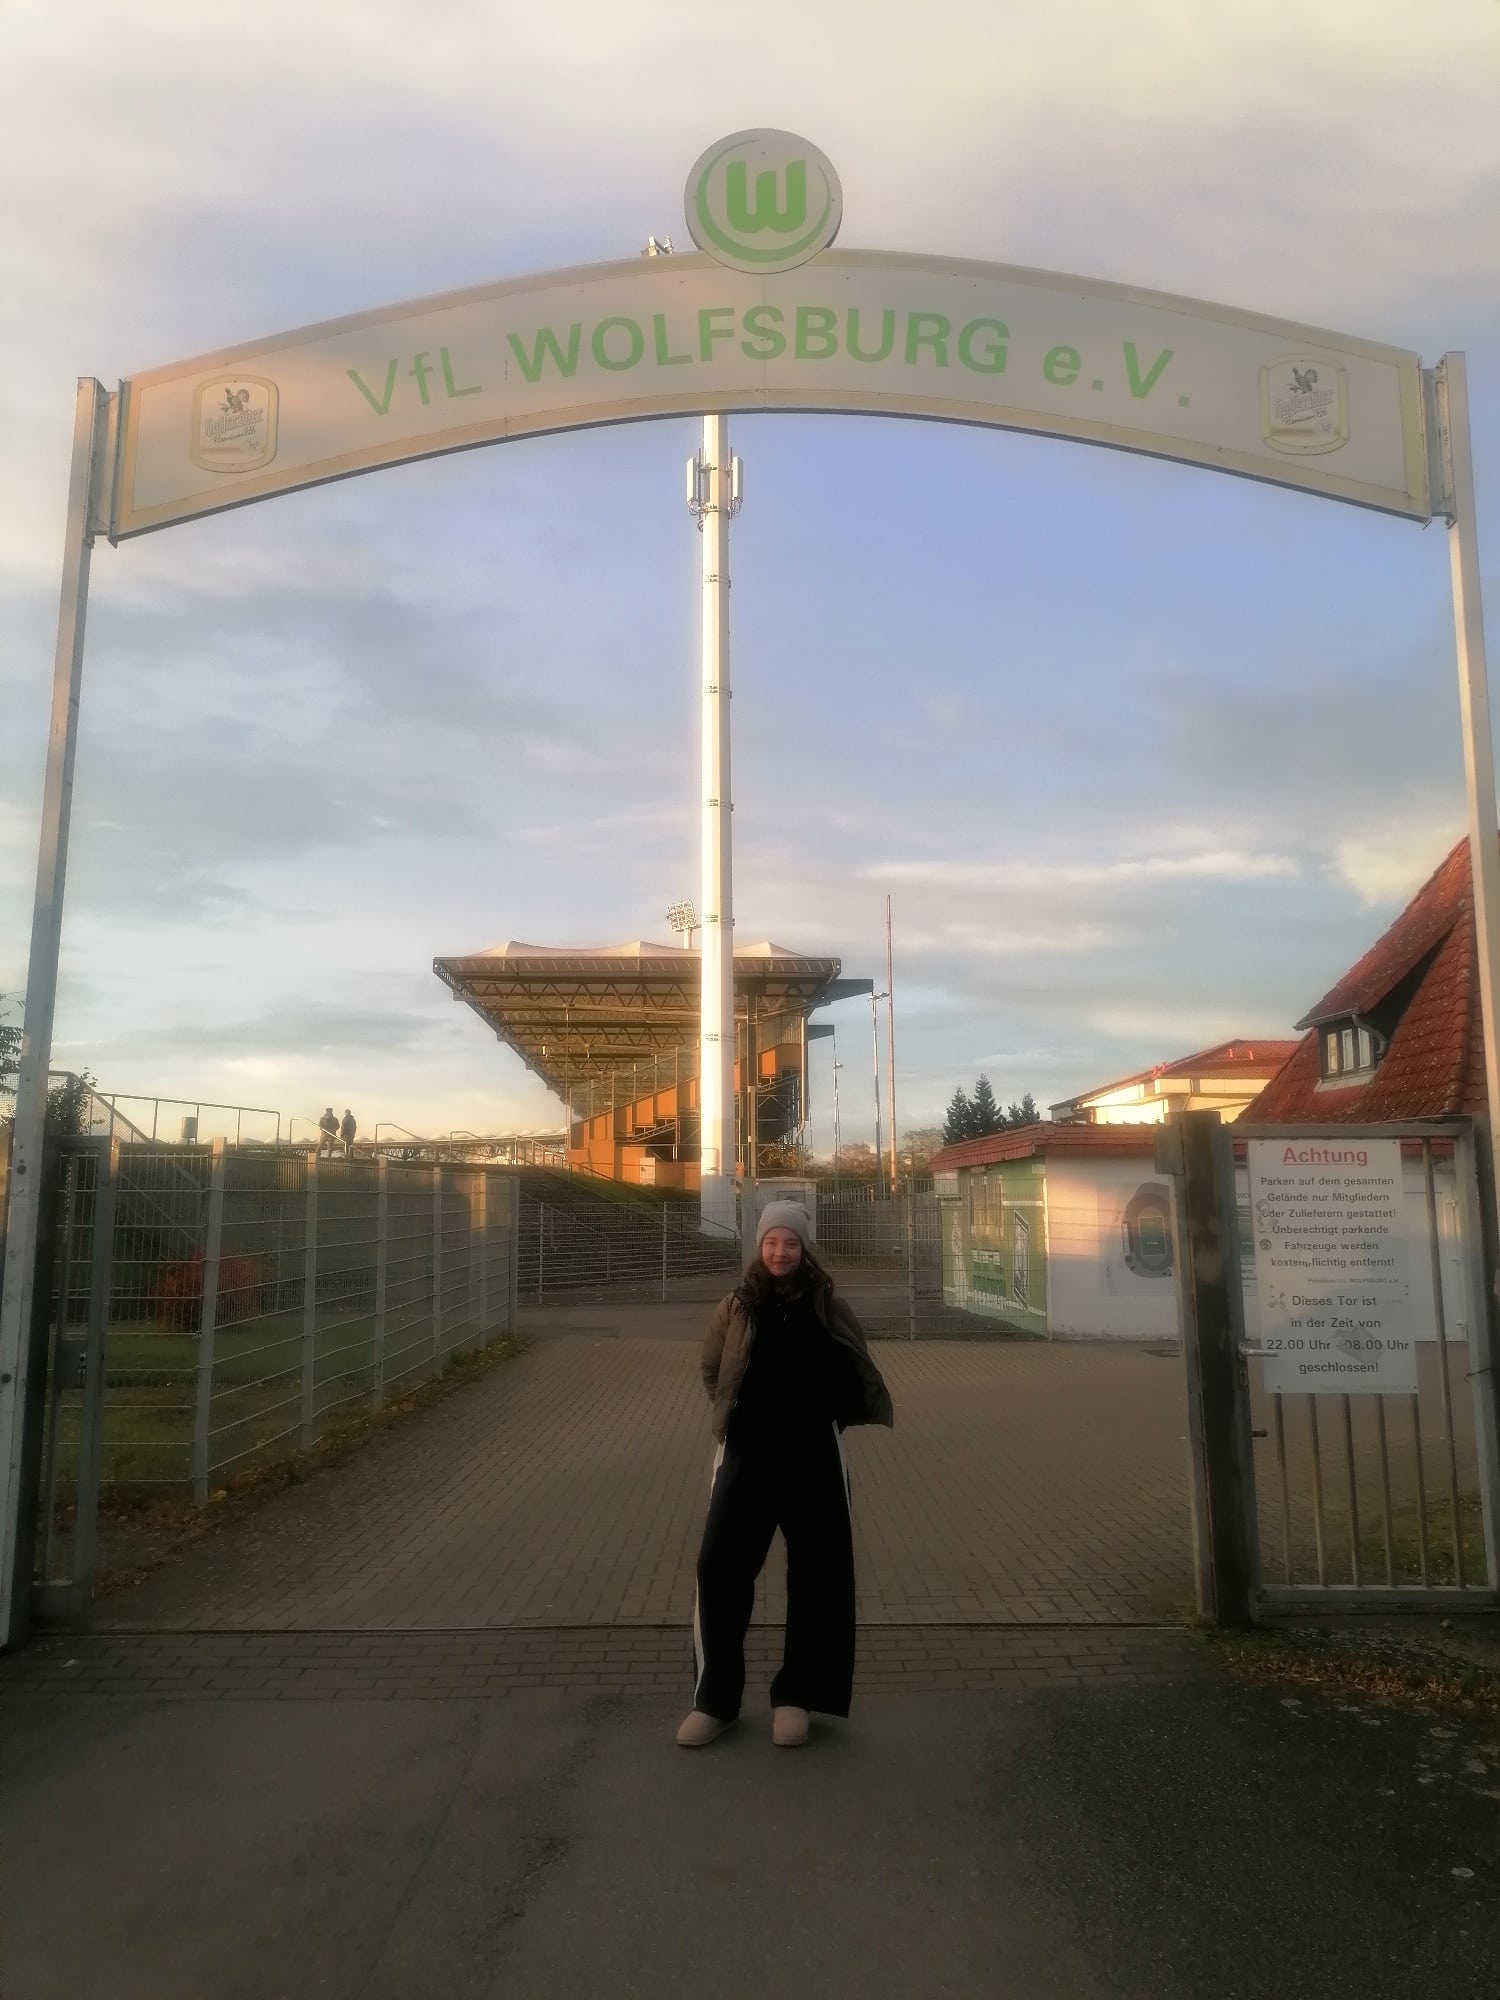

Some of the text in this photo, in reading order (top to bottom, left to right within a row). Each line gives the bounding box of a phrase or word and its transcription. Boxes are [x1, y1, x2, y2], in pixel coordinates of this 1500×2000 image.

[726, 160, 807, 234] W
[346, 306, 1191, 416] VfL WOLFSBURG e.V.
[1283, 1147, 1368, 1166] Achtung
[1260, 1177, 1394, 1187] Parken auf dem gesamten
[1268, 1193, 1308, 1202] Gelände
[1332, 1193, 1390, 1203] Mitgliedern
[1289, 1208, 1343, 1217] Zulieferern
[1347, 1209, 1396, 1219] gestattet!
[1272, 1225, 1389, 1235] Unberechtigt parkende
[1284, 1241, 1379, 1251] Fahrzeuge werden
[1350, 1257, 1395, 1267] entfernt!
[1292, 1296, 1377, 1306] Dieses Tor ist
[1291, 1318, 1381, 1328] in der Zeit von
[1266, 1340, 1304, 1350] 22.00
[1309, 1340, 1331, 1350] Uhr
[1344, 1340, 1382, 1350] 08.00
[1387, 1340, 1409, 1350] Uhr
[1299, 1362, 1379, 1375] geschlossen!
